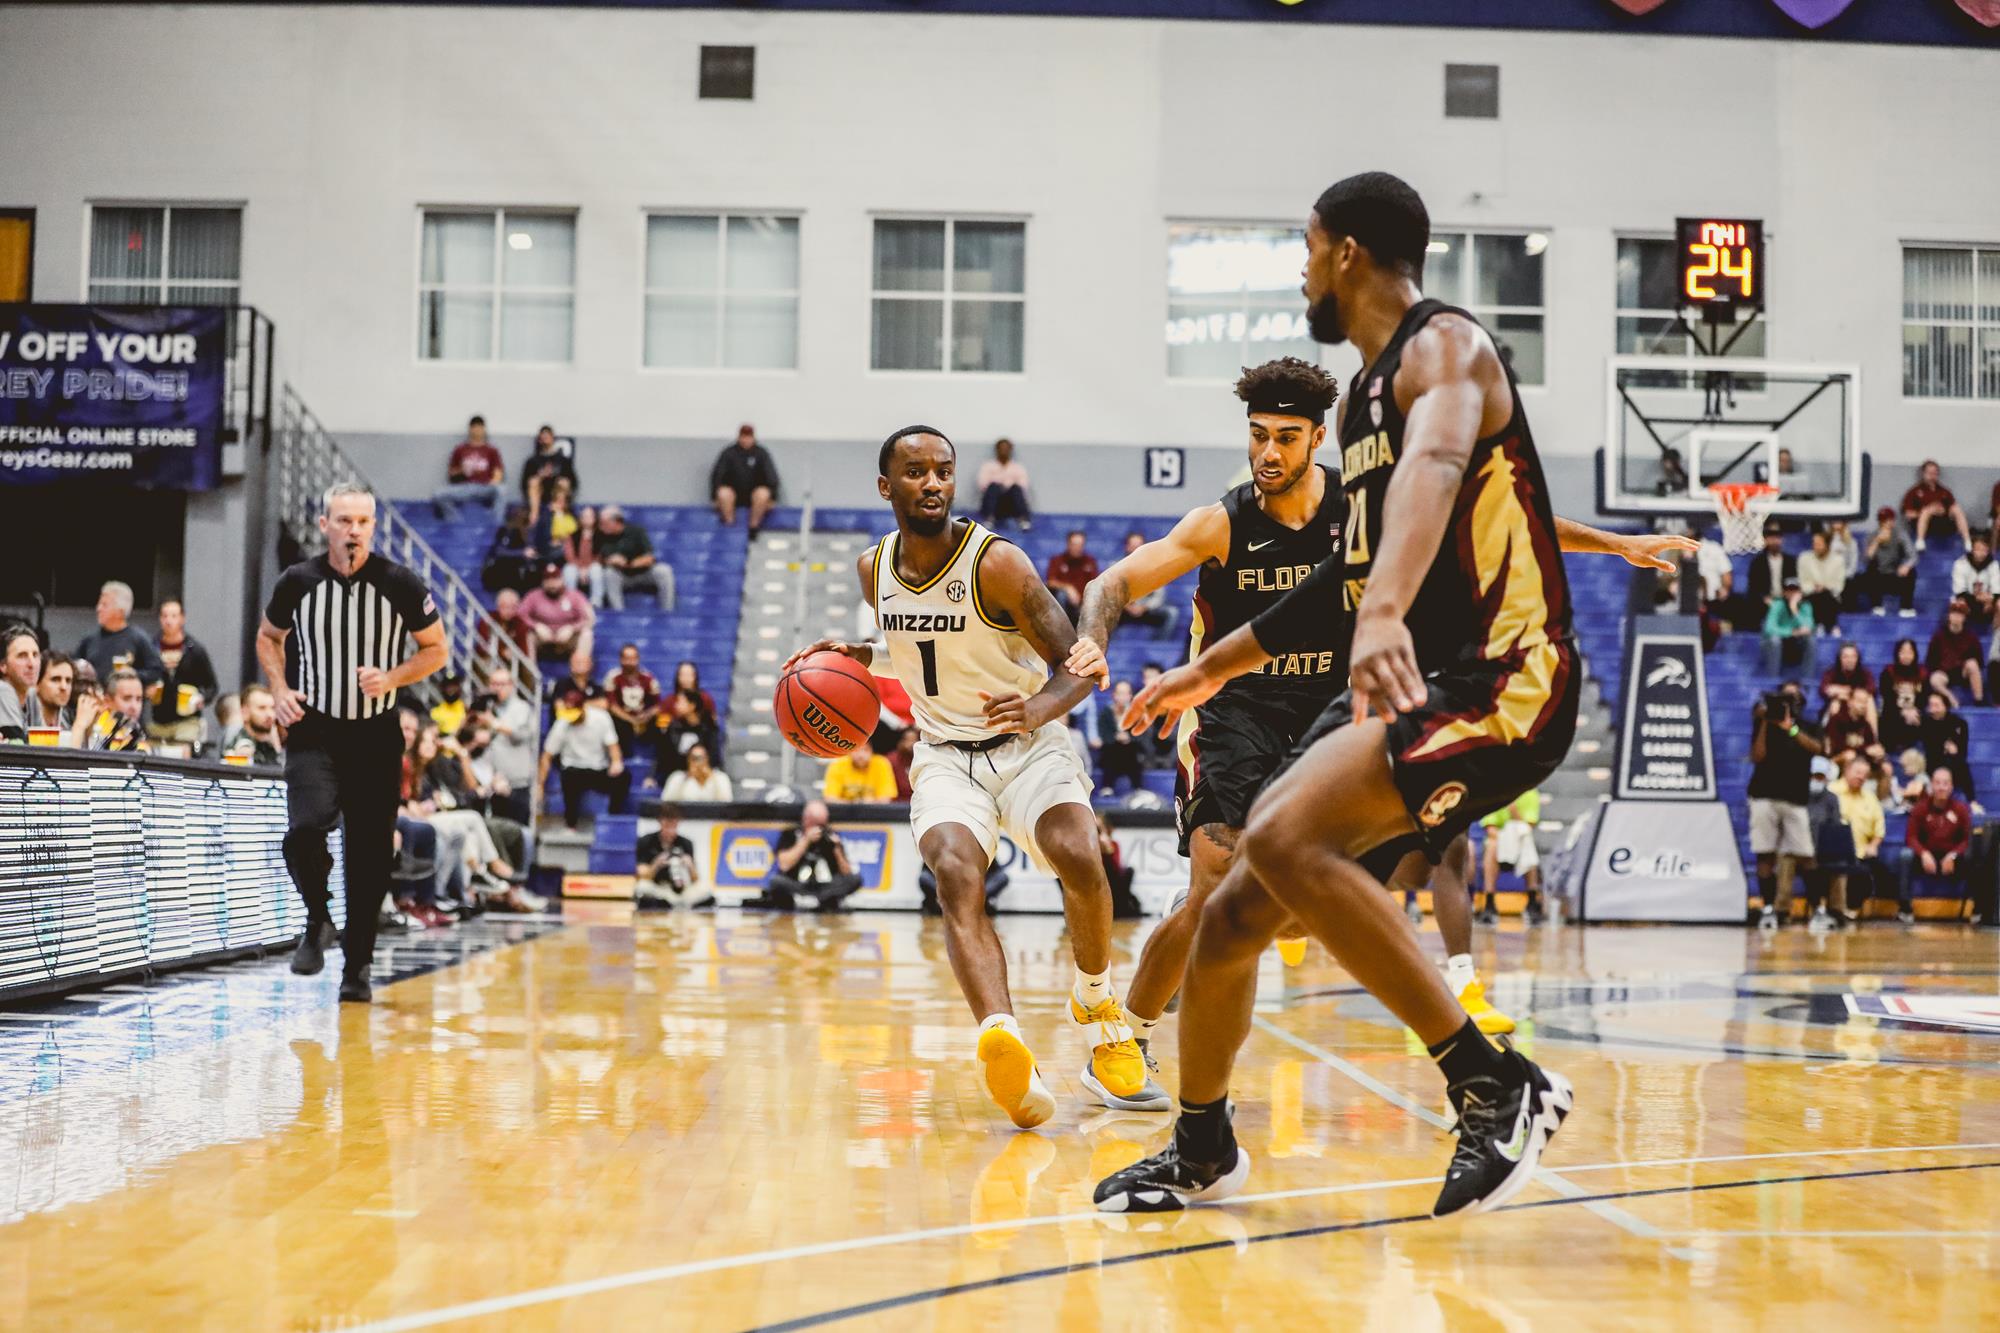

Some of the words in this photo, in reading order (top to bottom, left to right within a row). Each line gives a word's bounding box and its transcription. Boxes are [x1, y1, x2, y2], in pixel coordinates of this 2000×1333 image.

[1686, 244, 1752, 298] 24
[19, 331, 88, 362] OFF
[96, 333, 196, 364] YOUR
[63, 368, 189, 401] PRIDE!
[67, 427, 134, 446] ONLINE
[137, 428, 197, 447] STORE
[0, 448, 133, 470] eysGear.com
[1150, 450, 1180, 486] 19
[949, 583, 965, 601] SEC
[1237, 563, 1320, 591] FLOR
[883, 613, 966, 632] MIZZOU
[916, 639, 938, 696] 1
[802, 703, 857, 750] Wilson
